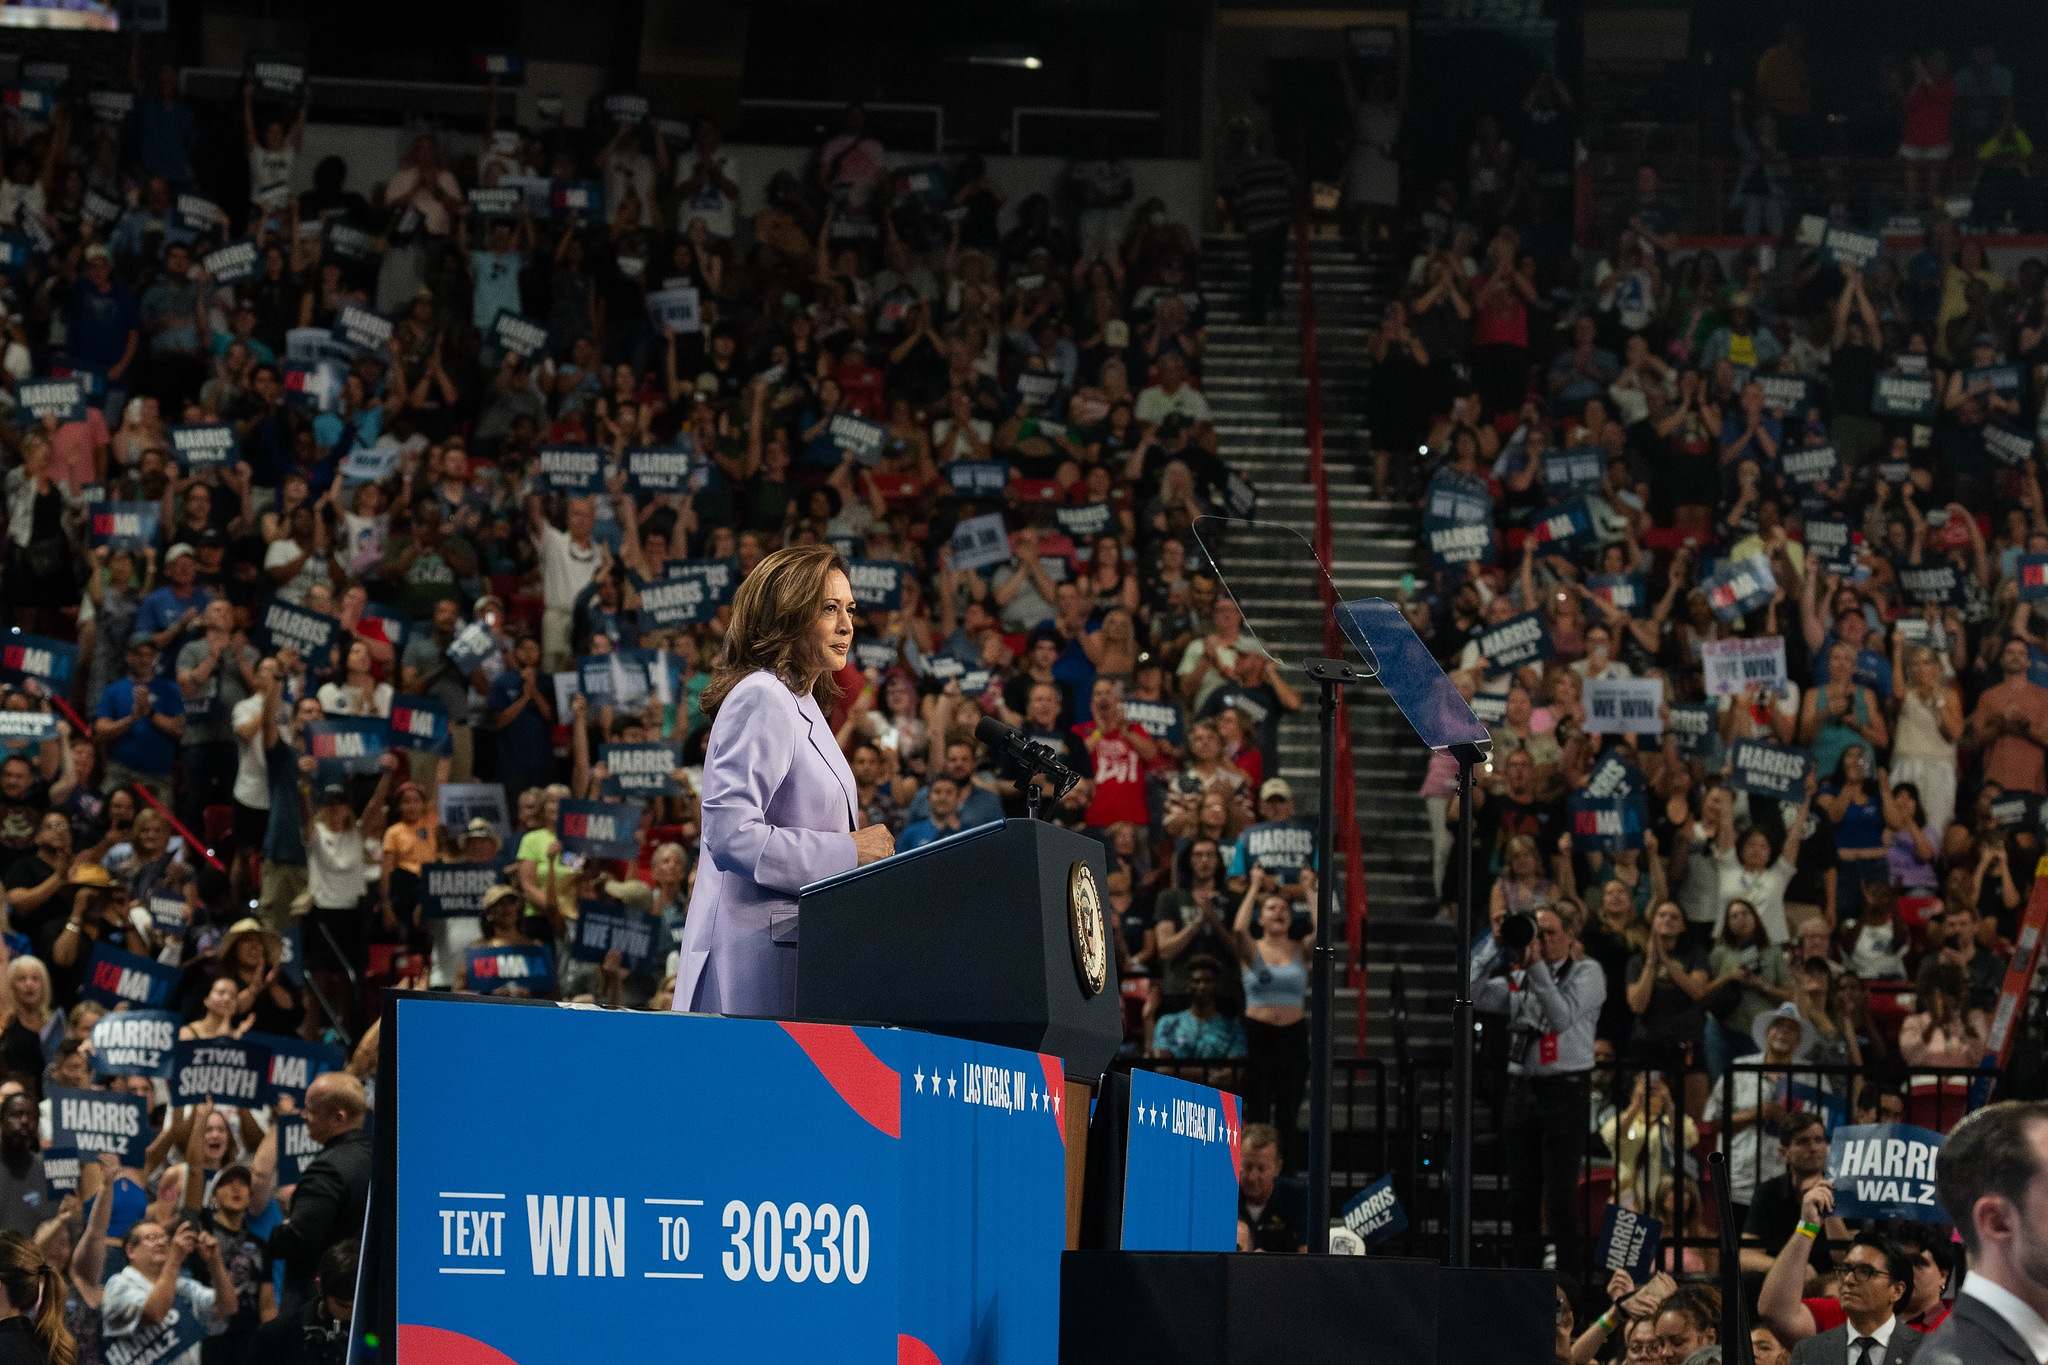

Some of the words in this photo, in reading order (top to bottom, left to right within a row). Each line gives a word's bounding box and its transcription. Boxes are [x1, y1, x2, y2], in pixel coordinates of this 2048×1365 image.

[173, 427, 232, 450] HARRIS
[540, 451, 599, 473] HARRIS
[629, 453, 688, 475] HARRIS
[640, 581, 704, 611] HARRIS
[1481, 617, 1542, 658] HARRIS
[1743, 657, 1778, 679] WIN
[1591, 697, 1615, 718] WE
[1620, 697, 1655, 718] WIN
[607, 750, 675, 776] HARRIS
[1737, 744, 1805, 780] HARRIS
[617, 774, 665, 790] WALZ
[1746, 766, 1790, 793] WALZ
[1249, 828, 1313, 857] HARRIS
[429, 870, 497, 897] HARRIS
[94, 1019, 174, 1051] HARRIS
[107, 1046, 161, 1068] WALZ
[193, 1047, 248, 1065] WALZ
[179, 1066, 258, 1100] HARRIS
[964, 1062, 981, 1104] LAS
[982, 1065, 1012, 1115] VEGAS,
[1013, 1071, 1026, 1112] NV
[61, 1098, 140, 1137] HARRIS
[1172, 1098, 1185, 1133] LAS
[1185, 1101, 1207, 1146] VEGAS,
[1207, 1107, 1217, 1142] NV
[76, 1131, 128, 1156] WALZ
[44, 1157, 80, 1180] HARRIS
[1840, 1139, 1939, 1182] HARRI
[52, 1176, 78, 1190] WALZ
[1857, 1180, 1936, 1206] WALZ
[1345, 1185, 1396, 1232] HARRIS
[1355, 1209, 1393, 1238] WALZ
[439, 1210, 506, 1257] TEXT
[526, 1194, 626, 1277] WIN
[659, 1216, 690, 1261] TO
[721, 1200, 870, 1285] 30330
[1606, 1208, 1638, 1272] HARRIS
[1625, 1225, 1648, 1268] WALZ
